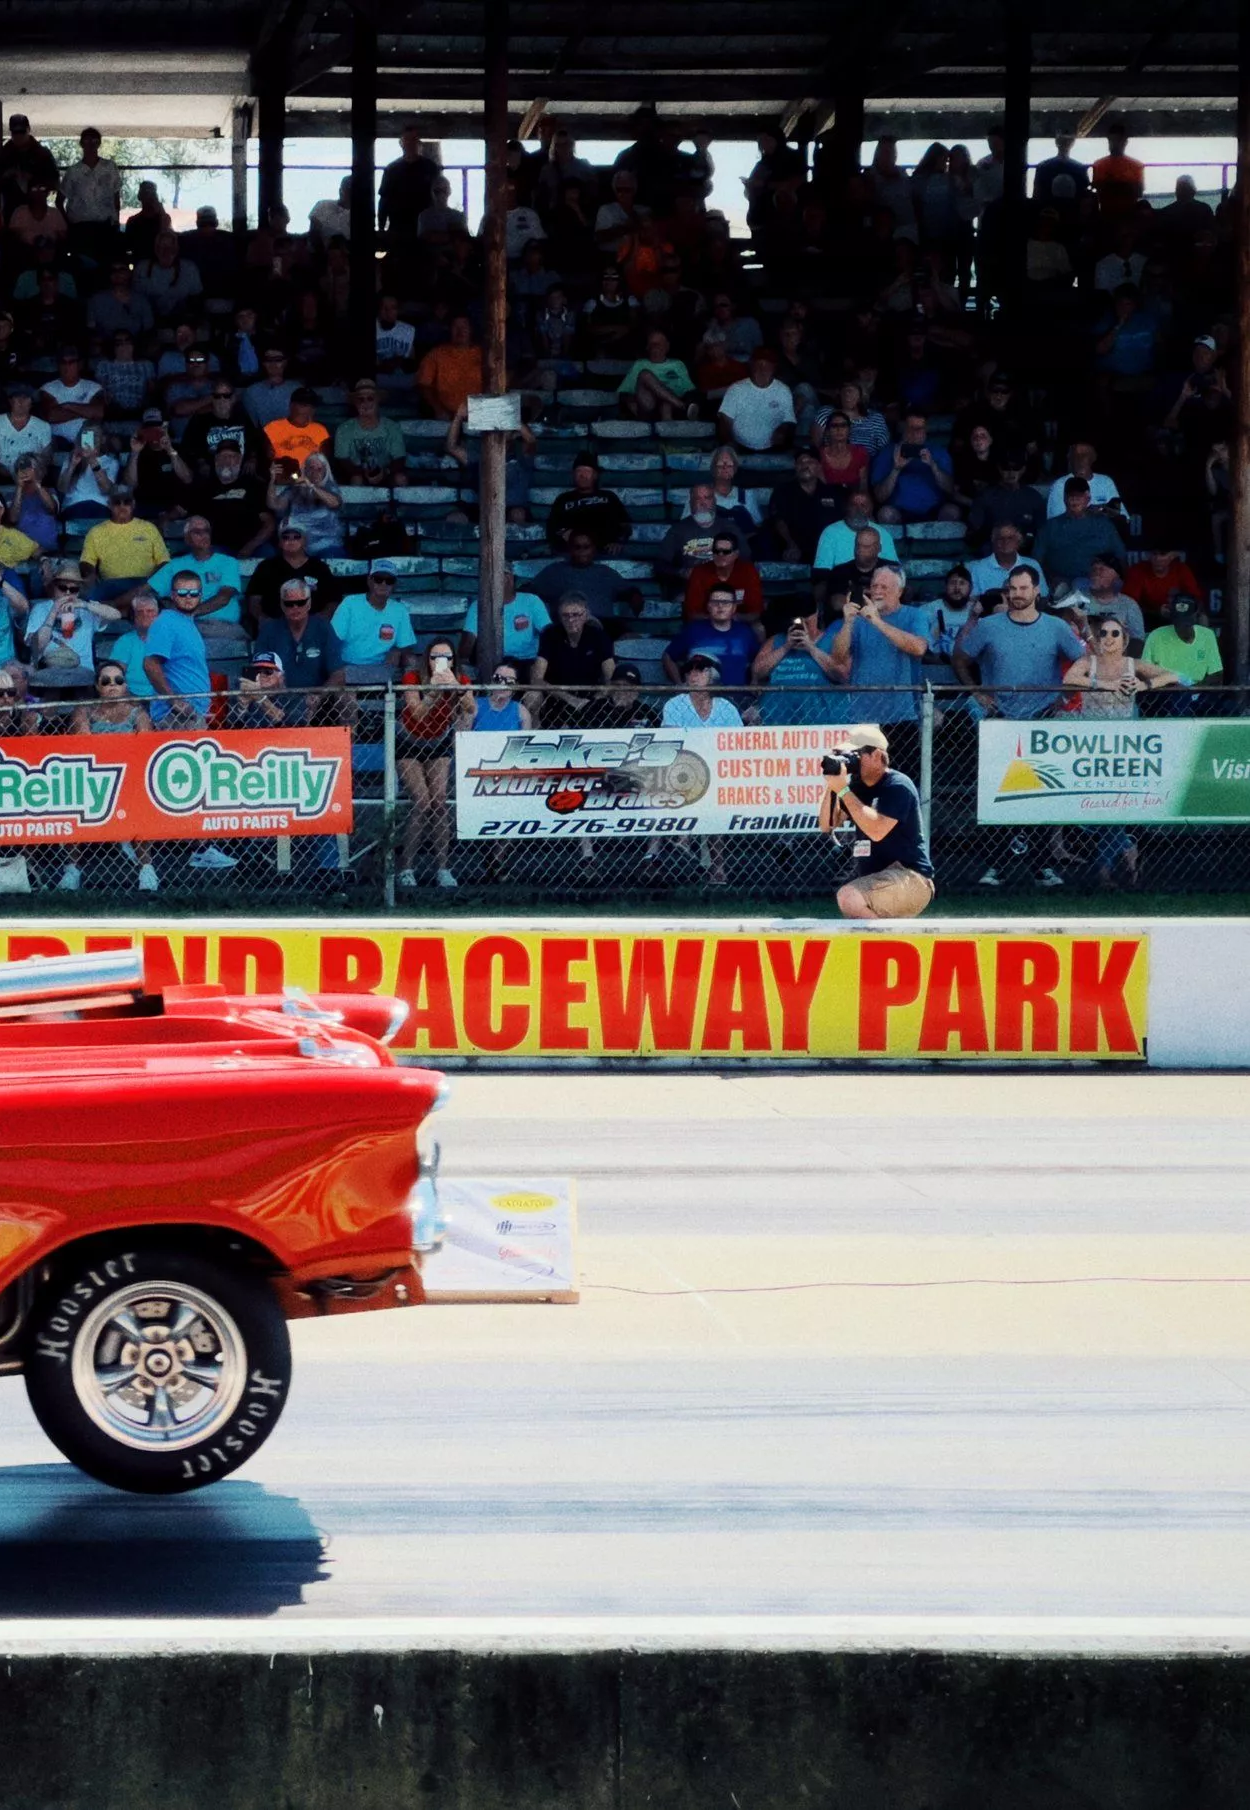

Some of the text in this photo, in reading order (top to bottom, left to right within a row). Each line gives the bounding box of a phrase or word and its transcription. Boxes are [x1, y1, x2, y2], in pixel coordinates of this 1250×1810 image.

[717, 731, 778, 751] GENERAL
[782, 730, 819, 750] AUTO
[1031, 730, 1162, 755] BOWLING
[481, 734, 684, 769] Jake's
[155, 747, 327, 808] O'Reilly
[717, 758, 790, 778] CUSTOM
[1072, 757, 1162, 778] GREEN
[1073, 780, 1163, 789] KENTUCKY
[718, 786, 770, 806] BRAKES
[775, 788, 783, 804] &
[26, 822, 73, 836] PARTS
[202, 815, 288, 831] AUTO PARTS
[478, 817, 699, 836] 270-776-9980
[858, 939, 1142, 1054] PARK
[38, 1252, 139, 1364] Hoosier
[182, 1369, 283, 1479] Hoosier
